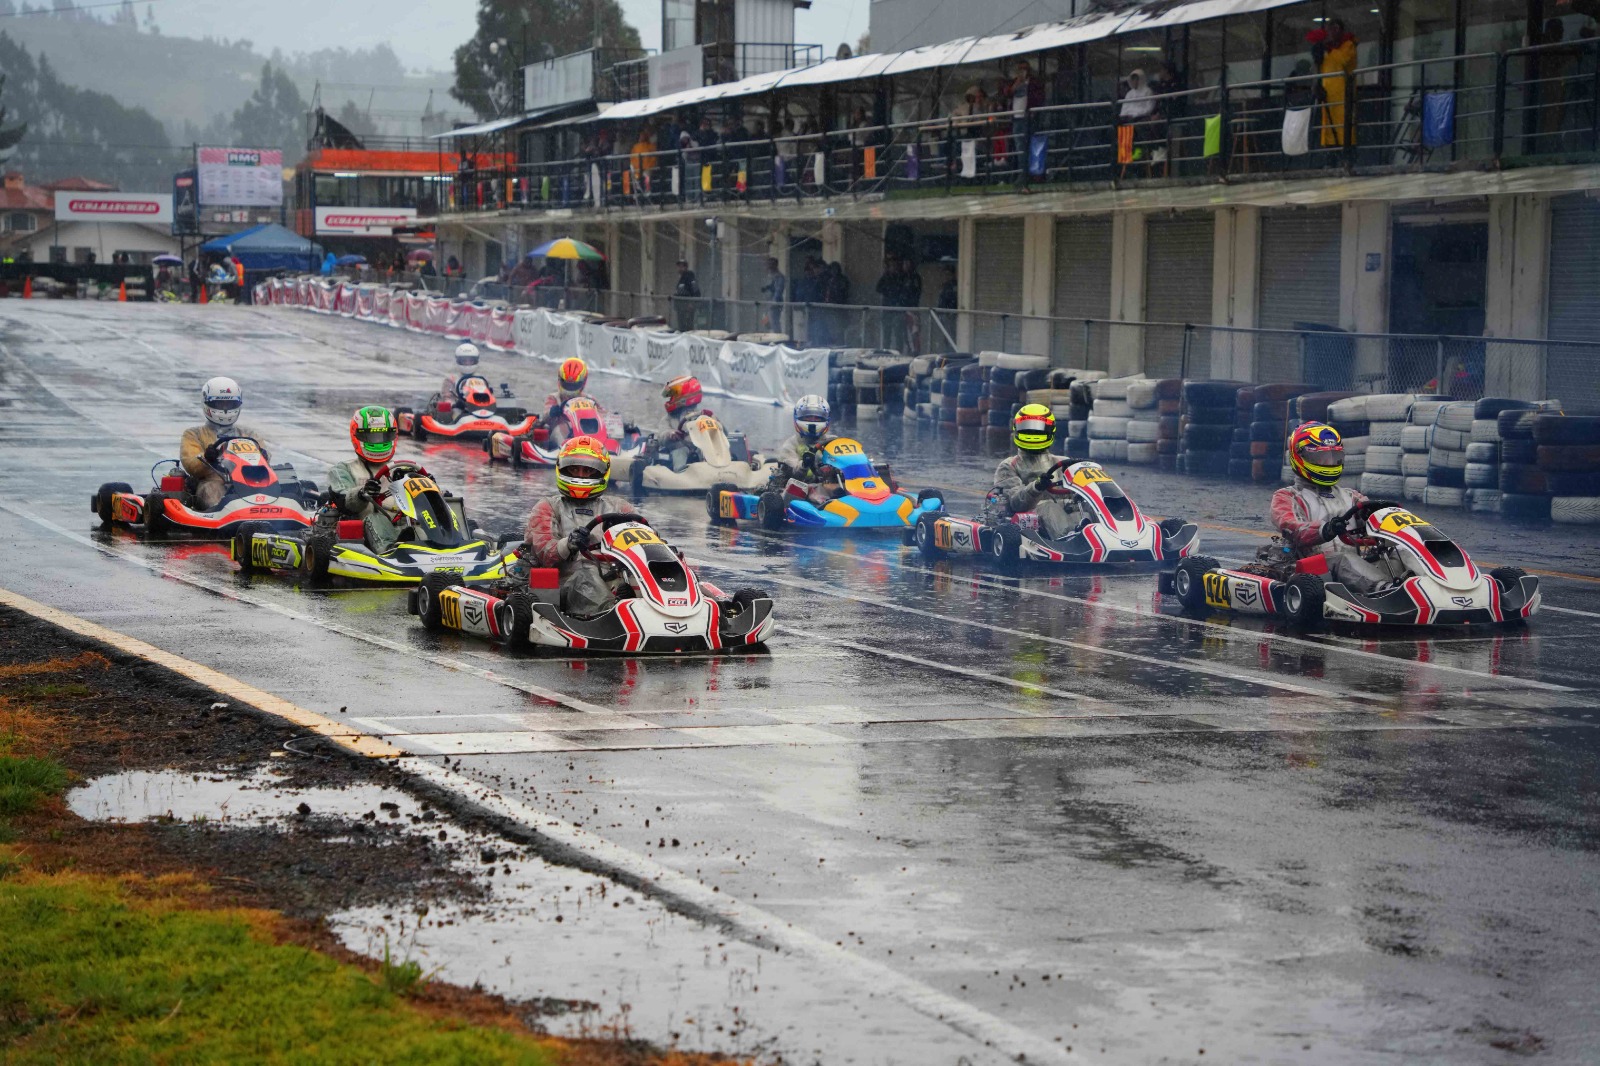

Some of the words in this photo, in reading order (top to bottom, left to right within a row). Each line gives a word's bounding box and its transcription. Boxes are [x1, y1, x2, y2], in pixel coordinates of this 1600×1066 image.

[834, 444, 858, 455] 437
[249, 507, 284, 515] SODI
[421, 509, 437, 529] RCM
[271, 547, 287, 558] RCM
[1206, 574, 1231, 604] 424
[440, 594, 460, 628] 407
